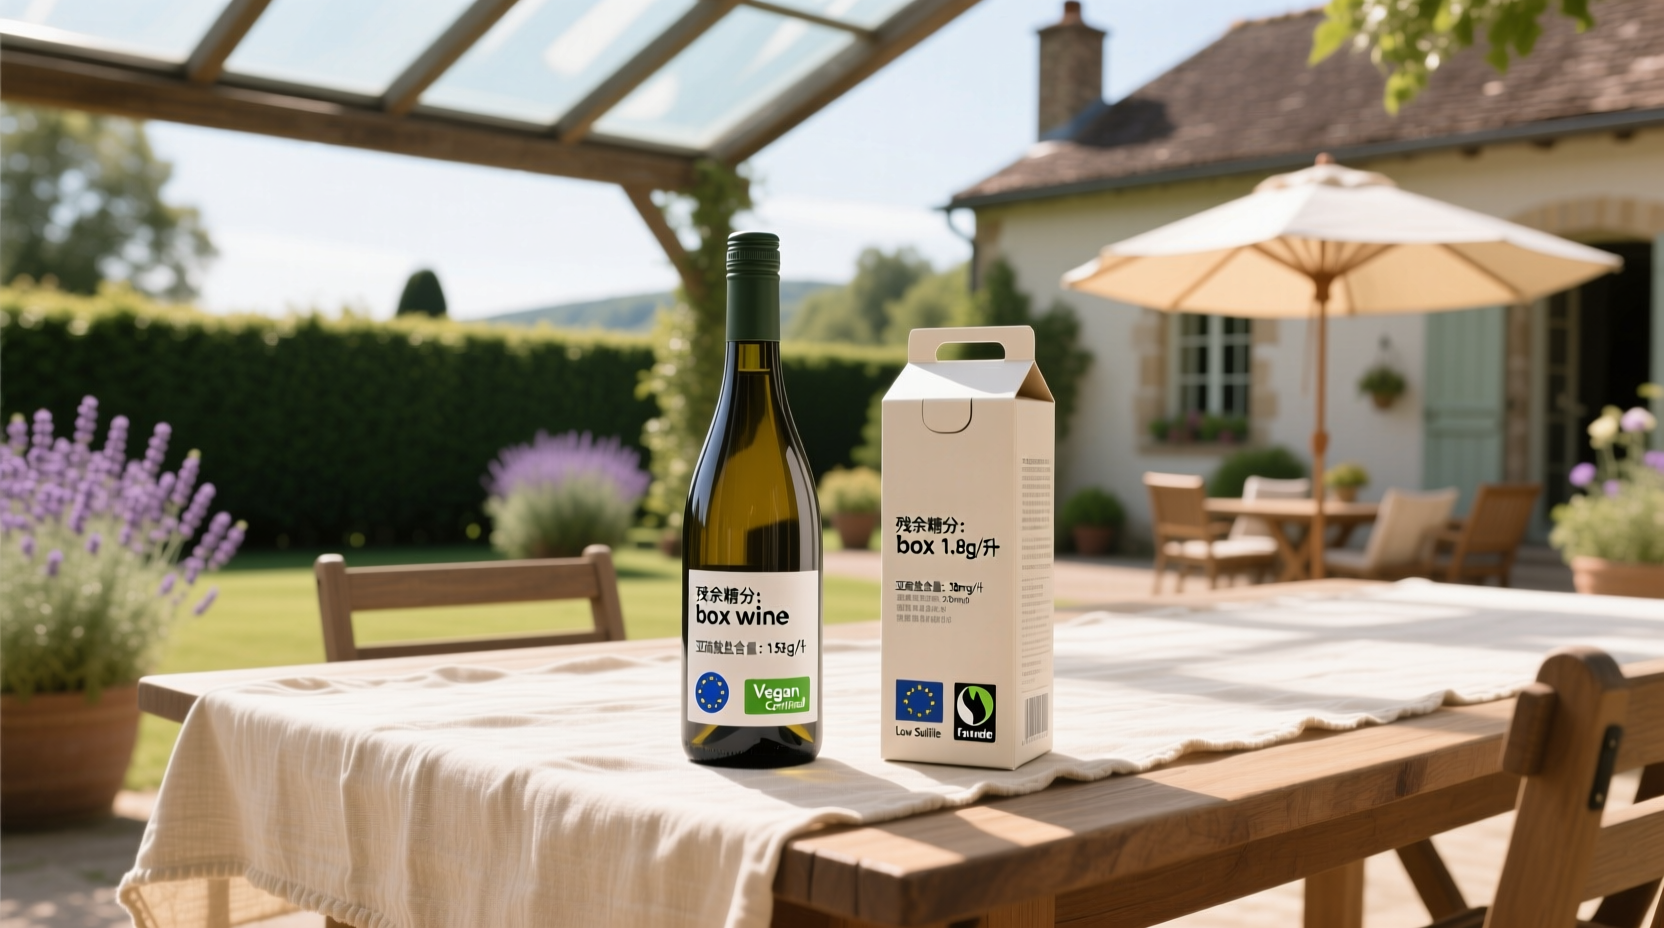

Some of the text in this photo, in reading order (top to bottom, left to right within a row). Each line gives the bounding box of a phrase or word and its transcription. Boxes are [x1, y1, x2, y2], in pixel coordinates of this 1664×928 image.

[896, 534, 1000, 560] box 1.8g/升
[696, 603, 790, 625] box wine
[753, 683, 800, 702] Vegan
[895, 726, 912, 737] Low
